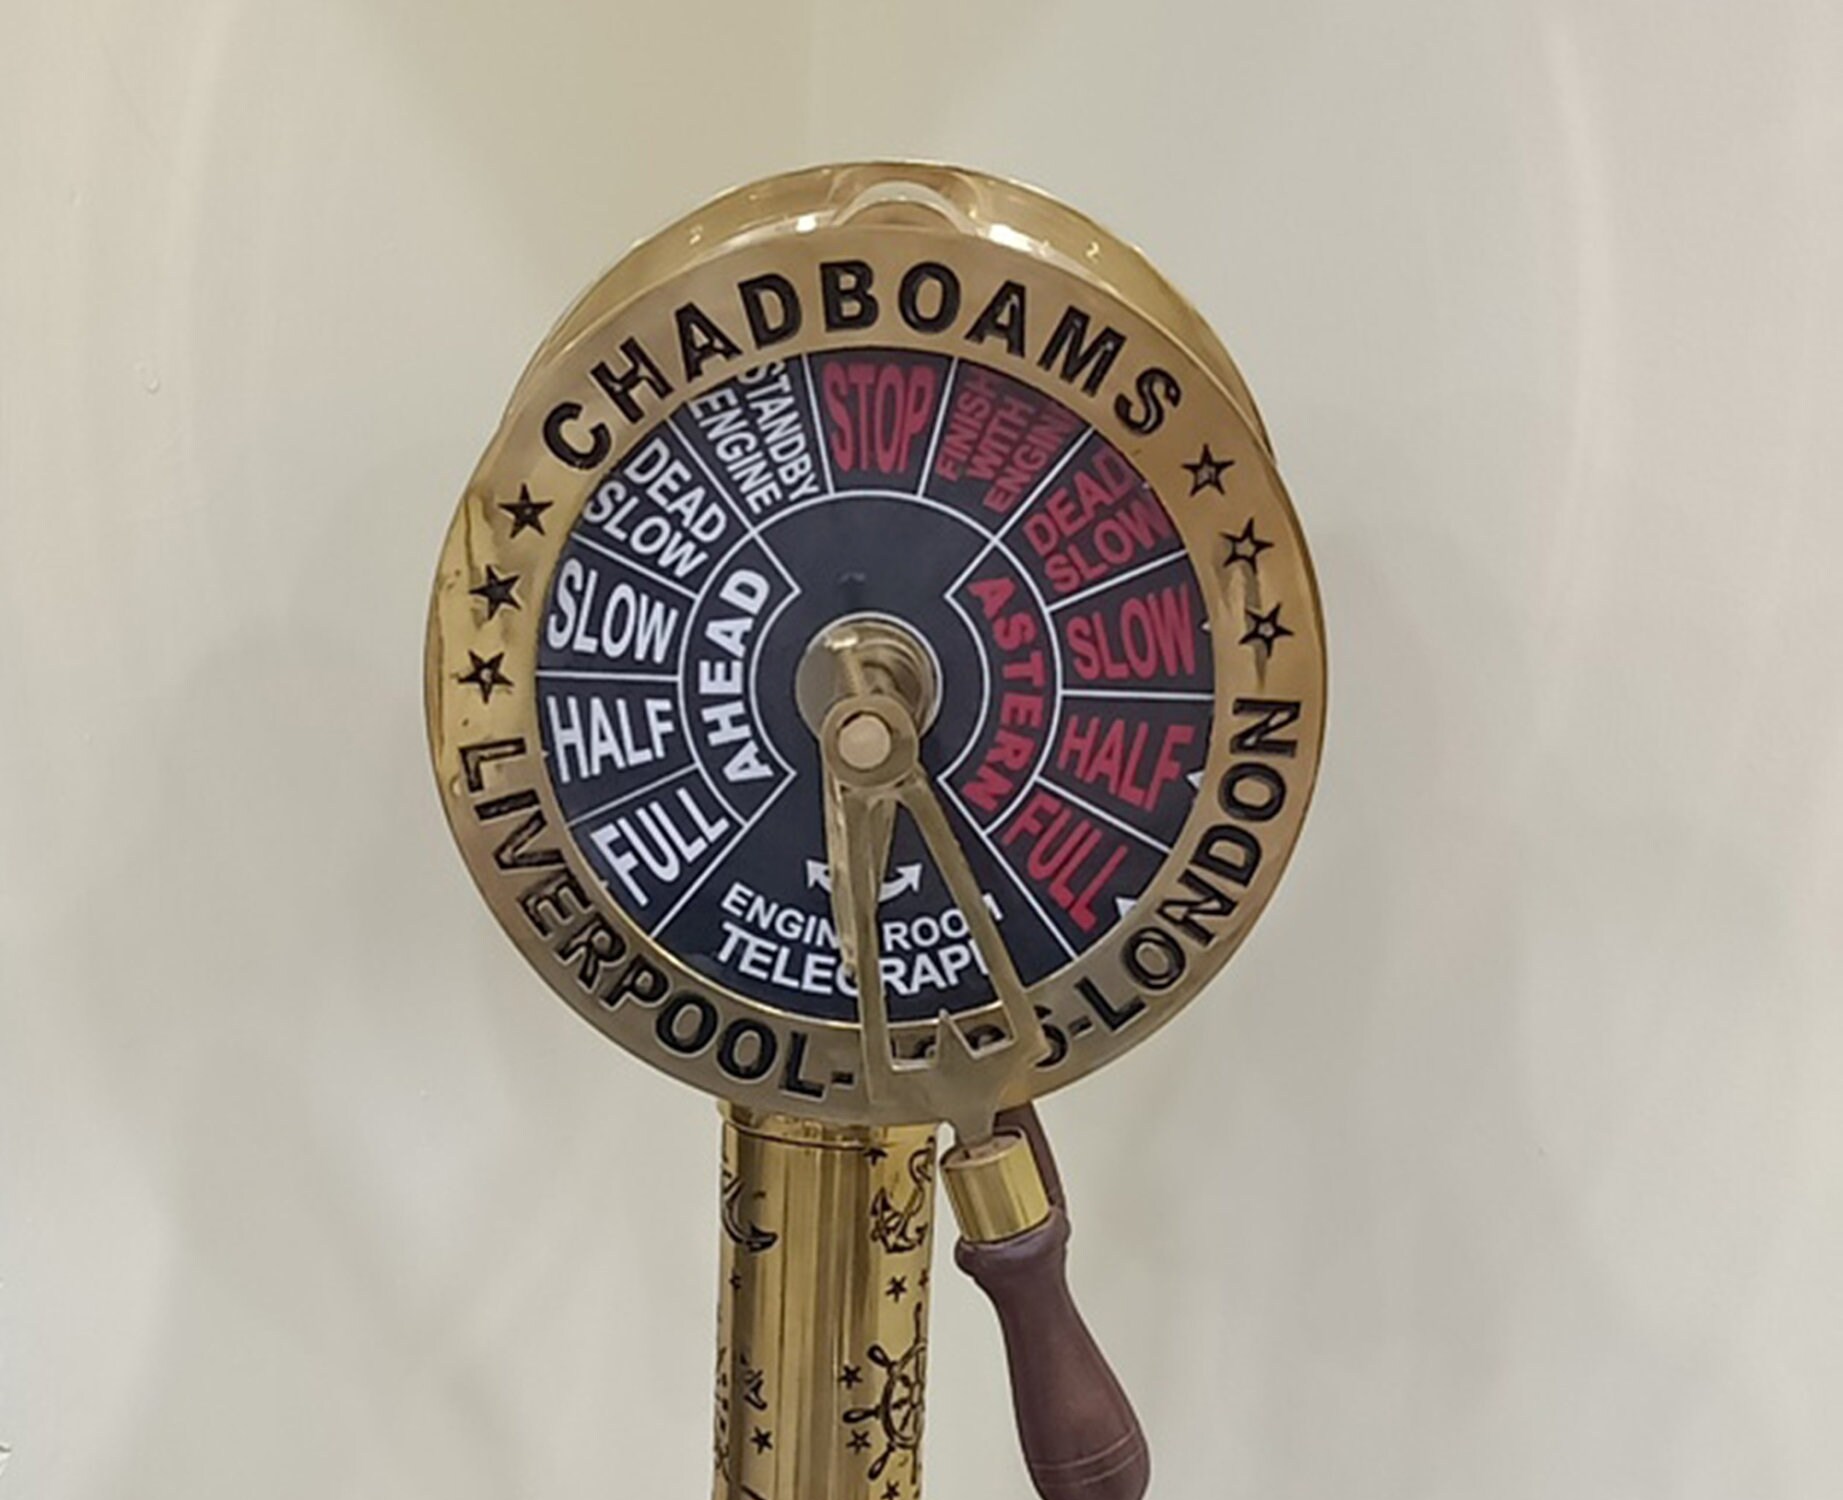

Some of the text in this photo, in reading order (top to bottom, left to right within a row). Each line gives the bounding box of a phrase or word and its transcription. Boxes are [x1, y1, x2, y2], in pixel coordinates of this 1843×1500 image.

[542, 259, 1183, 470] CHADBOAMS
[823, 362, 936, 474] STOP
[688, 387, 784, 514] ENGINE
[737, 360, 820, 501] STANDBY
[965, 393, 1035, 481] WITH
[983, 402, 1080, 514] ENGIN
[584, 481, 709, 579] SLOW
[625, 437, 727, 543] DEAD
[1023, 447, 1138, 557] DEAD
[1045, 499, 1174, 594] SLOW
[546, 558, 680, 664] SLOW
[1066, 582, 1196, 681] SLOW
[699, 569, 775, 783] AHEAD
[961, 575, 1047, 812] ASTERN
[546, 696, 675, 784] HALF
[1056, 713, 1195, 811] HALF
[589, 787, 730, 907] FULL
[1003, 791, 1128, 931] FULL
[721, 882, 1004, 952] ENGIN ROO
